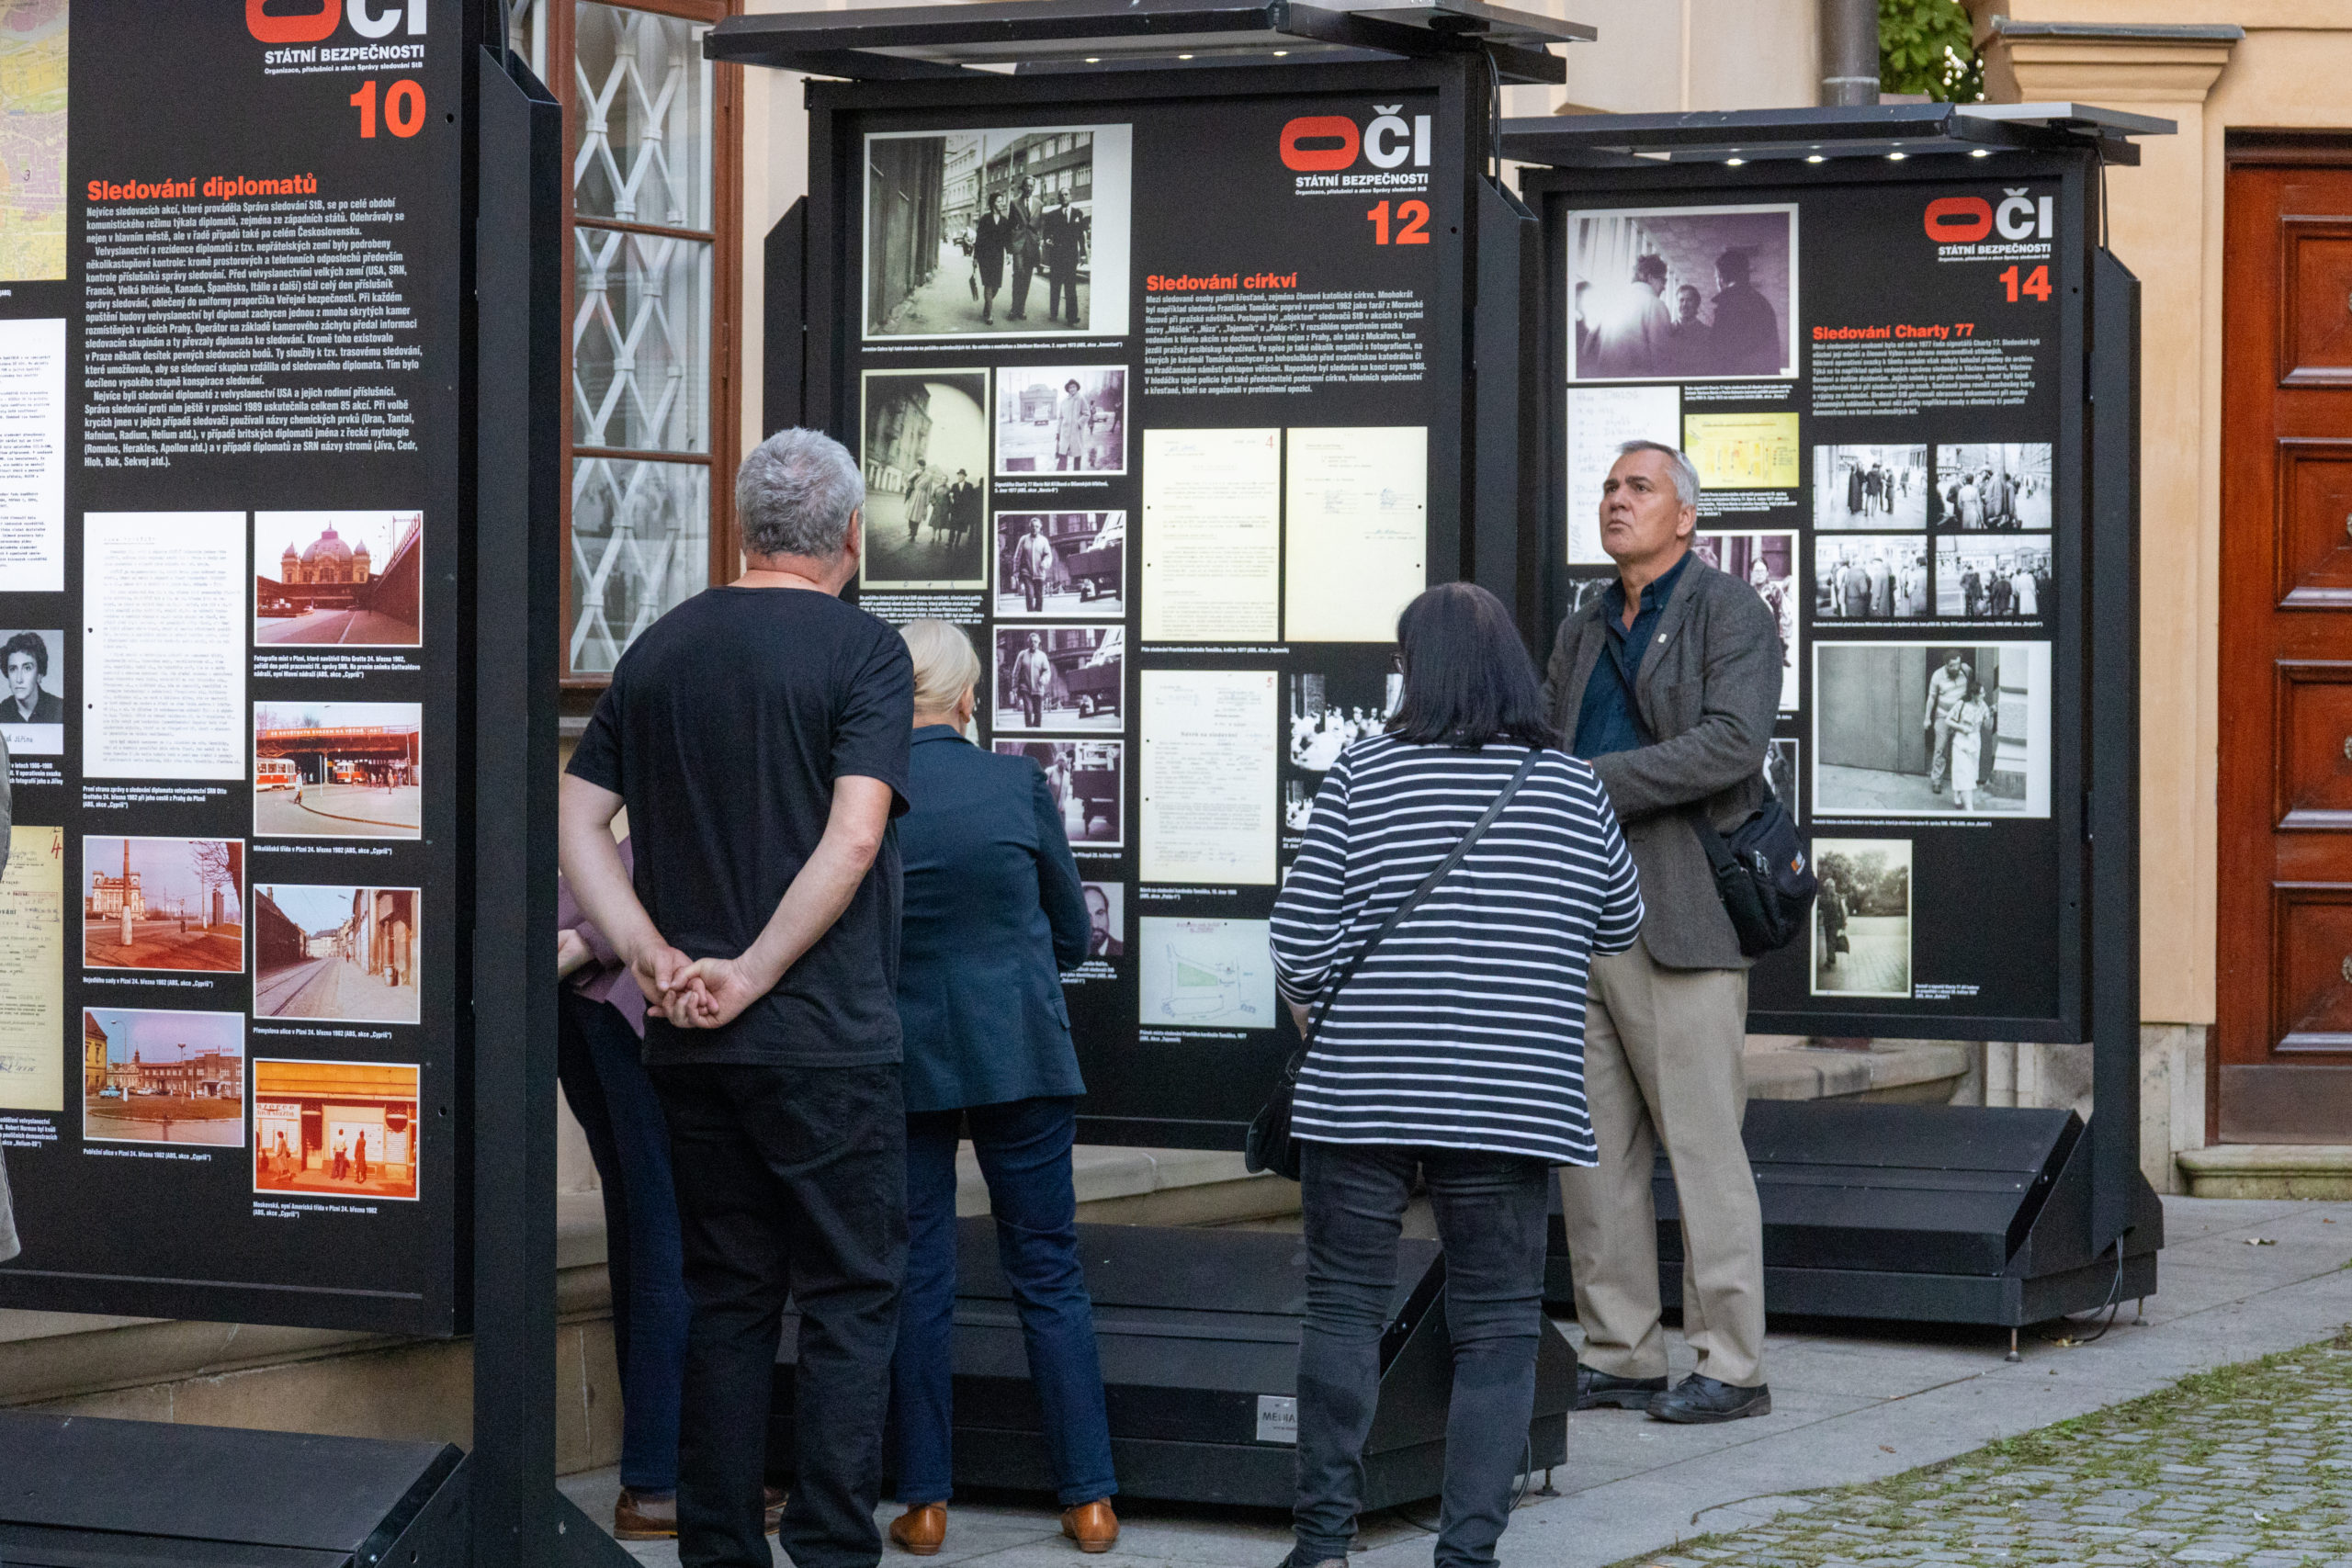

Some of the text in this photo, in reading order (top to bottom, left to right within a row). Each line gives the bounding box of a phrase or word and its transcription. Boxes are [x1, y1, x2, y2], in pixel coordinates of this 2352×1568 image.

[265, 44, 424, 63] STÁTNÍ BEZPEČNOSTI
[264, 66, 300, 74] Organizace,
[301, 64, 334, 73] příslušníci
[350, 80, 425, 139] 10
[1280, 105, 1431, 172] OČI
[88, 173, 317, 200] Sledování diplomatů
[1295, 173, 1428, 187] STÁTNÍ BEZPEČNOSTI
[86, 206, 114, 219] Nejvíce
[115, 205, 160, 216] sledovacích
[161, 204, 180, 217] akcí,
[181, 204, 202, 214] které
[204, 202, 242, 215] prováděla
[243, 201, 269, 214] Správa
[270, 200, 308, 211] sledování
[308, 200, 325, 212] StB,
[338, 202, 348, 211] po
[349, 198, 367, 209] celé
[368, 197, 396, 209] období
[1924, 187, 2052, 243] OČI
[86, 219, 144, 230] komunistického
[146, 218, 171, 228] režimu
[173, 217, 197, 230] týkala
[198, 216, 239, 229] diplomatů,
[240, 215, 272, 228] zejména
[283, 213, 322, 226] západních
[323, 212, 347, 222] států.
[349, 211, 393, 224] Odehrávaly
[1367, 200, 1430, 244] 12
[86, 233, 107, 244] nejen
[114, 231, 143, 242] hlavním
[145, 231, 171, 243] městě,
[173, 231, 185, 241] ale
[192, 230, 209, 240] řadě
[211, 230, 240, 242] případů
[242, 229, 259, 239] také
[261, 231, 271, 241] po
[272, 228, 296, 238] celém
[297, 225, 362, 237] Československu.
[96, 244, 150, 257] Velvyslanectví
[157, 244, 194, 254] rezidence
[195, 243, 233, 255] diplomatů
[240, 243, 254, 252] tzv.
[256, 241, 311, 254] nepřátelských
[311, 240, 331, 250] zemí
[332, 241, 349, 252] byly
[350, 240, 391, 252] podrobeny
[1939, 243, 2051, 255] STÁTNÍ BEZPEČNOSTI
[86, 257, 151, 271] několikastupňové
[152, 257, 186, 266] kontrole:
[187, 256, 211, 266] kromě
[212, 254, 263, 268] prostorových
[271, 254, 315, 265] telefonních
[316, 253, 361, 265] odposlechů
[362, 252, 402, 265] především
[1147, 273, 1296, 290] Sledování církví
[1999, 265, 2052, 302] 14
[1813, 323, 1973, 340] Sledování Charty 77
[85, 375, 265, 389] docíleno vysokého stupně konspirace sledování.
[51, 836, 62, 859] 4
